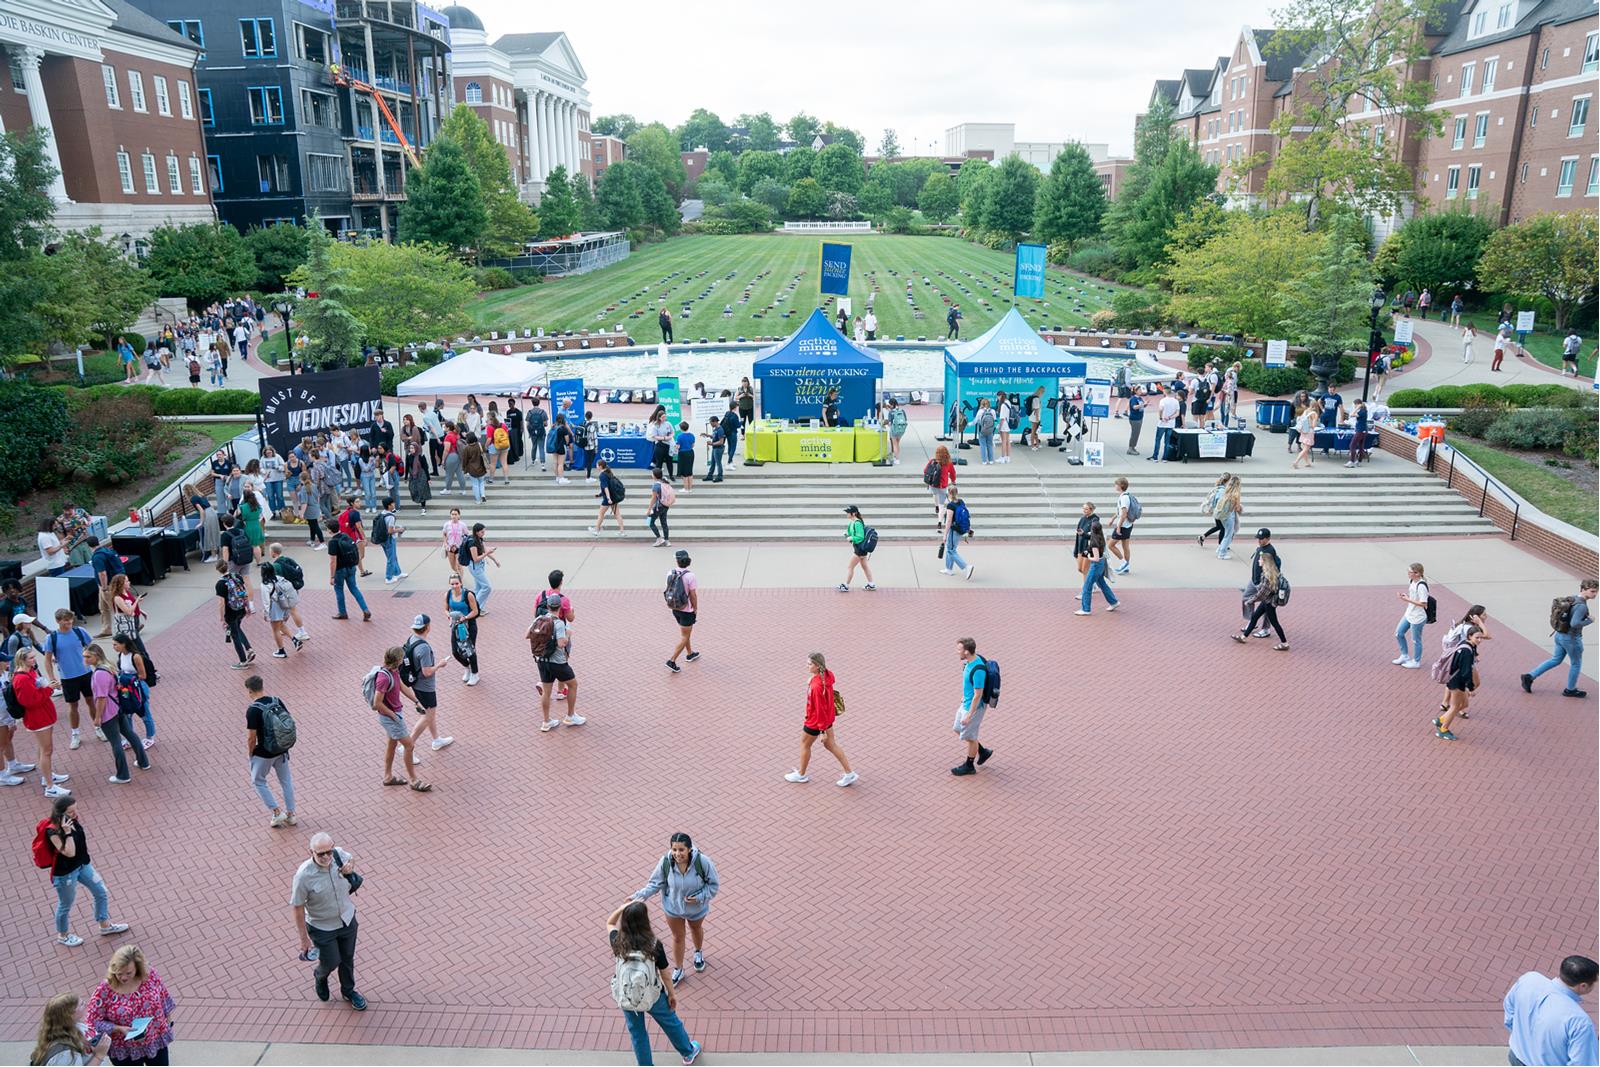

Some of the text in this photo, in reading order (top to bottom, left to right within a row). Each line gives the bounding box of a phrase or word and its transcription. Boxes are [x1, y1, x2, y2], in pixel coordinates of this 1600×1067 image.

[19, 20, 60, 40] BASKIN
[61, 31, 100, 50] CENTER
[823, 260, 847, 269] SEND
[799, 337, 837, 345] active
[799, 343, 838, 351] minds
[794, 366, 826, 377] silence
[795, 396, 843, 404] PACKI
[265, 387, 316, 435] IT MUST BE
[287, 399, 381, 433] WEDNESDAY
[801, 436, 832, 444] active
[800, 443, 832, 452] minds
